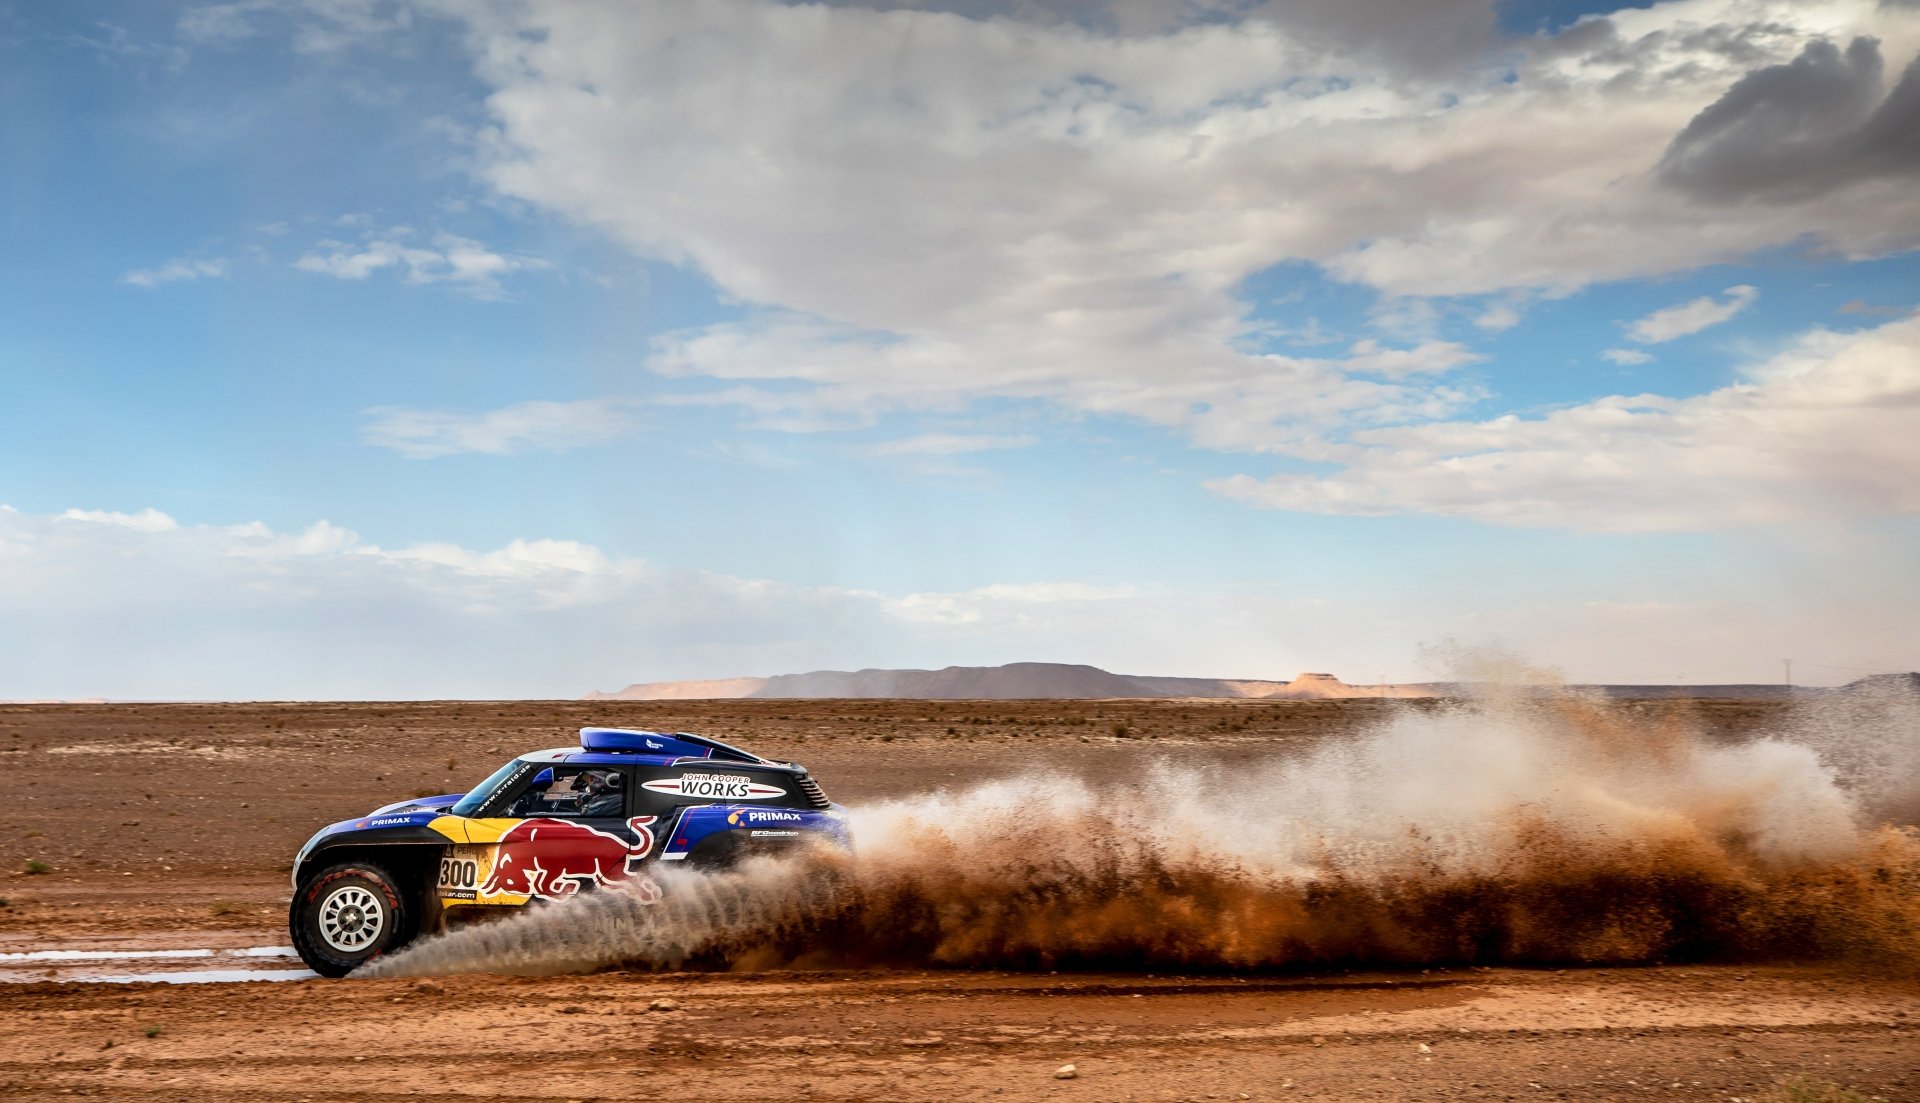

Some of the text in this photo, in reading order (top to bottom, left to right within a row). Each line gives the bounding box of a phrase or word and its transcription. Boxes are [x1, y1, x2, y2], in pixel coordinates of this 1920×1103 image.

[711, 774, 750, 784] COOPER
[477, 763, 531, 812] www.x-raid.de
[681, 780, 749, 797] WORKS
[371, 817, 411, 826] PRIMAX
[749, 812, 802, 822] PRIMAX
[440, 859, 476, 887] 300
